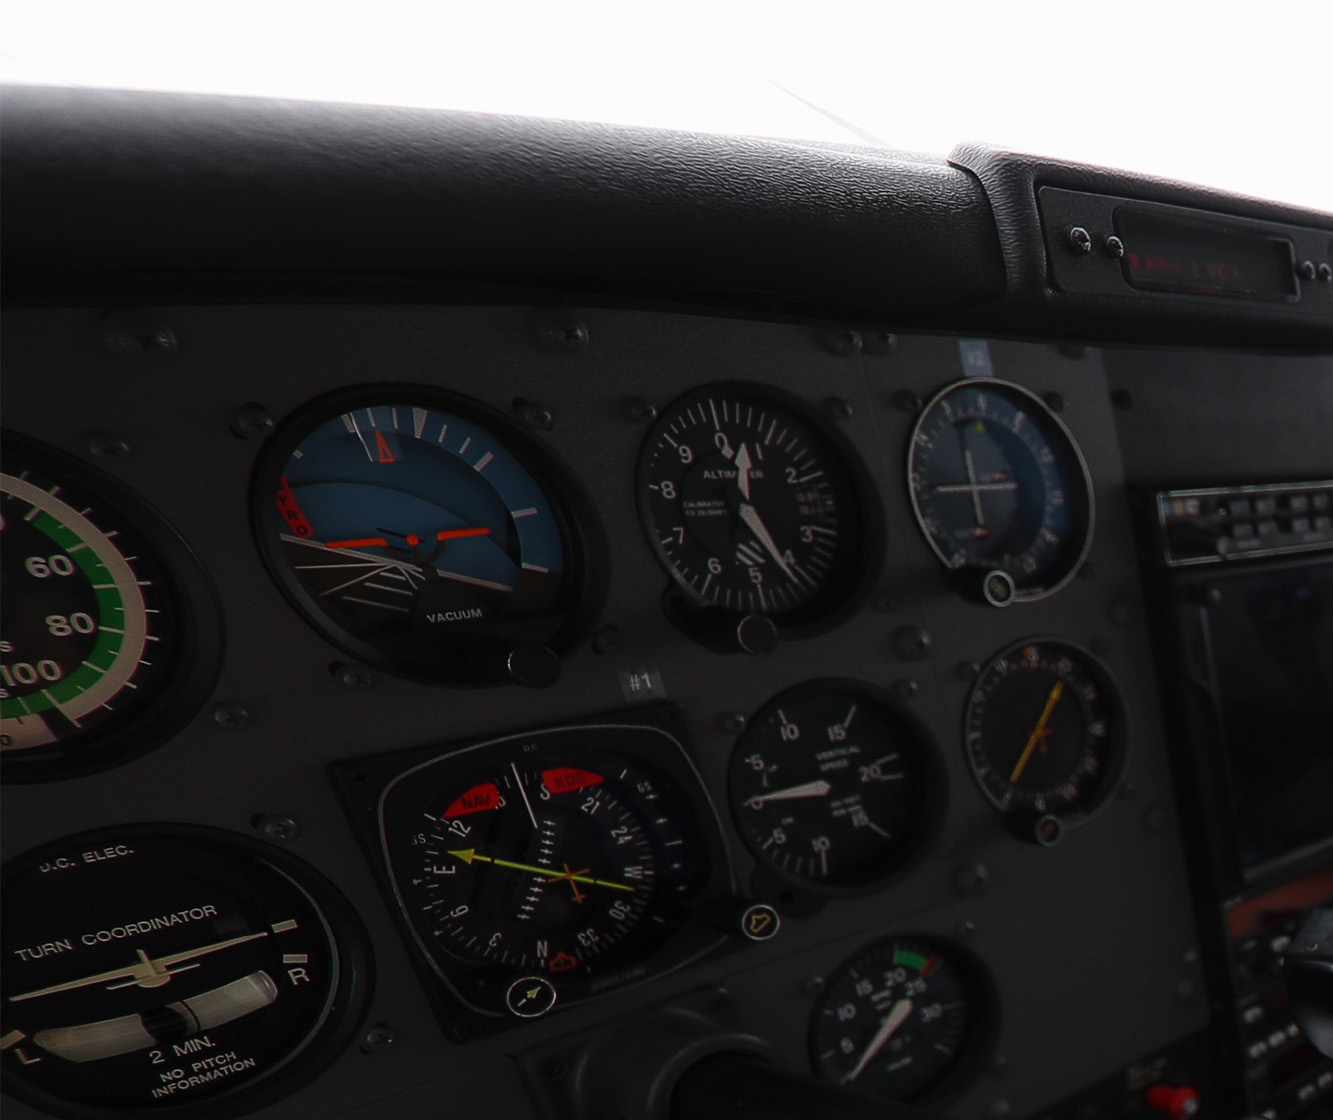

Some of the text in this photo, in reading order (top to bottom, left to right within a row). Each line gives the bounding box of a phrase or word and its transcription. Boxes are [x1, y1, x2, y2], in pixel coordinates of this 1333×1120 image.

[678, 445, 693, 464] 9
[785, 467, 800, 484] 2
[661, 480, 677, 499] 8
[672, 526, 686, 544] 7
[800, 525, 814, 543] 3
[708, 557, 721, 574] 6
[781, 549, 796, 565] 4
[25, 554, 76, 579] 60
[749, 567, 763, 583] 5
[45, 611, 97, 637] 80
[426, 608, 483, 624] VACUUM
[0, 660, 64, 687] 100
[629, 672, 653, 690] #1
[780, 723, 800, 742] 10
[827, 726, 847, 742] 15
[749, 754, 766, 771] 5
[858, 765, 882, 783] 20
[539, 783, 551, 801] S
[581, 796, 602, 816] 21
[447, 819, 472, 839] 12
[610, 825, 633, 846] 24
[772, 827, 787, 845] 5
[811, 836, 830, 853] 10
[82, 844, 135, 864] ELEC.
[432, 864, 456, 875] E
[608, 899, 631, 921] 30
[14, 904, 218, 962] TURN COORDINATOR
[536, 940, 549, 958] N
[286, 966, 311, 986] R
[15, 1048, 42, 1065] L
[149, 1036, 217, 1064] 2 MIN.
[159, 1051, 238, 1083] NO PITCH
[151, 1057, 257, 1099] INFORMATION
